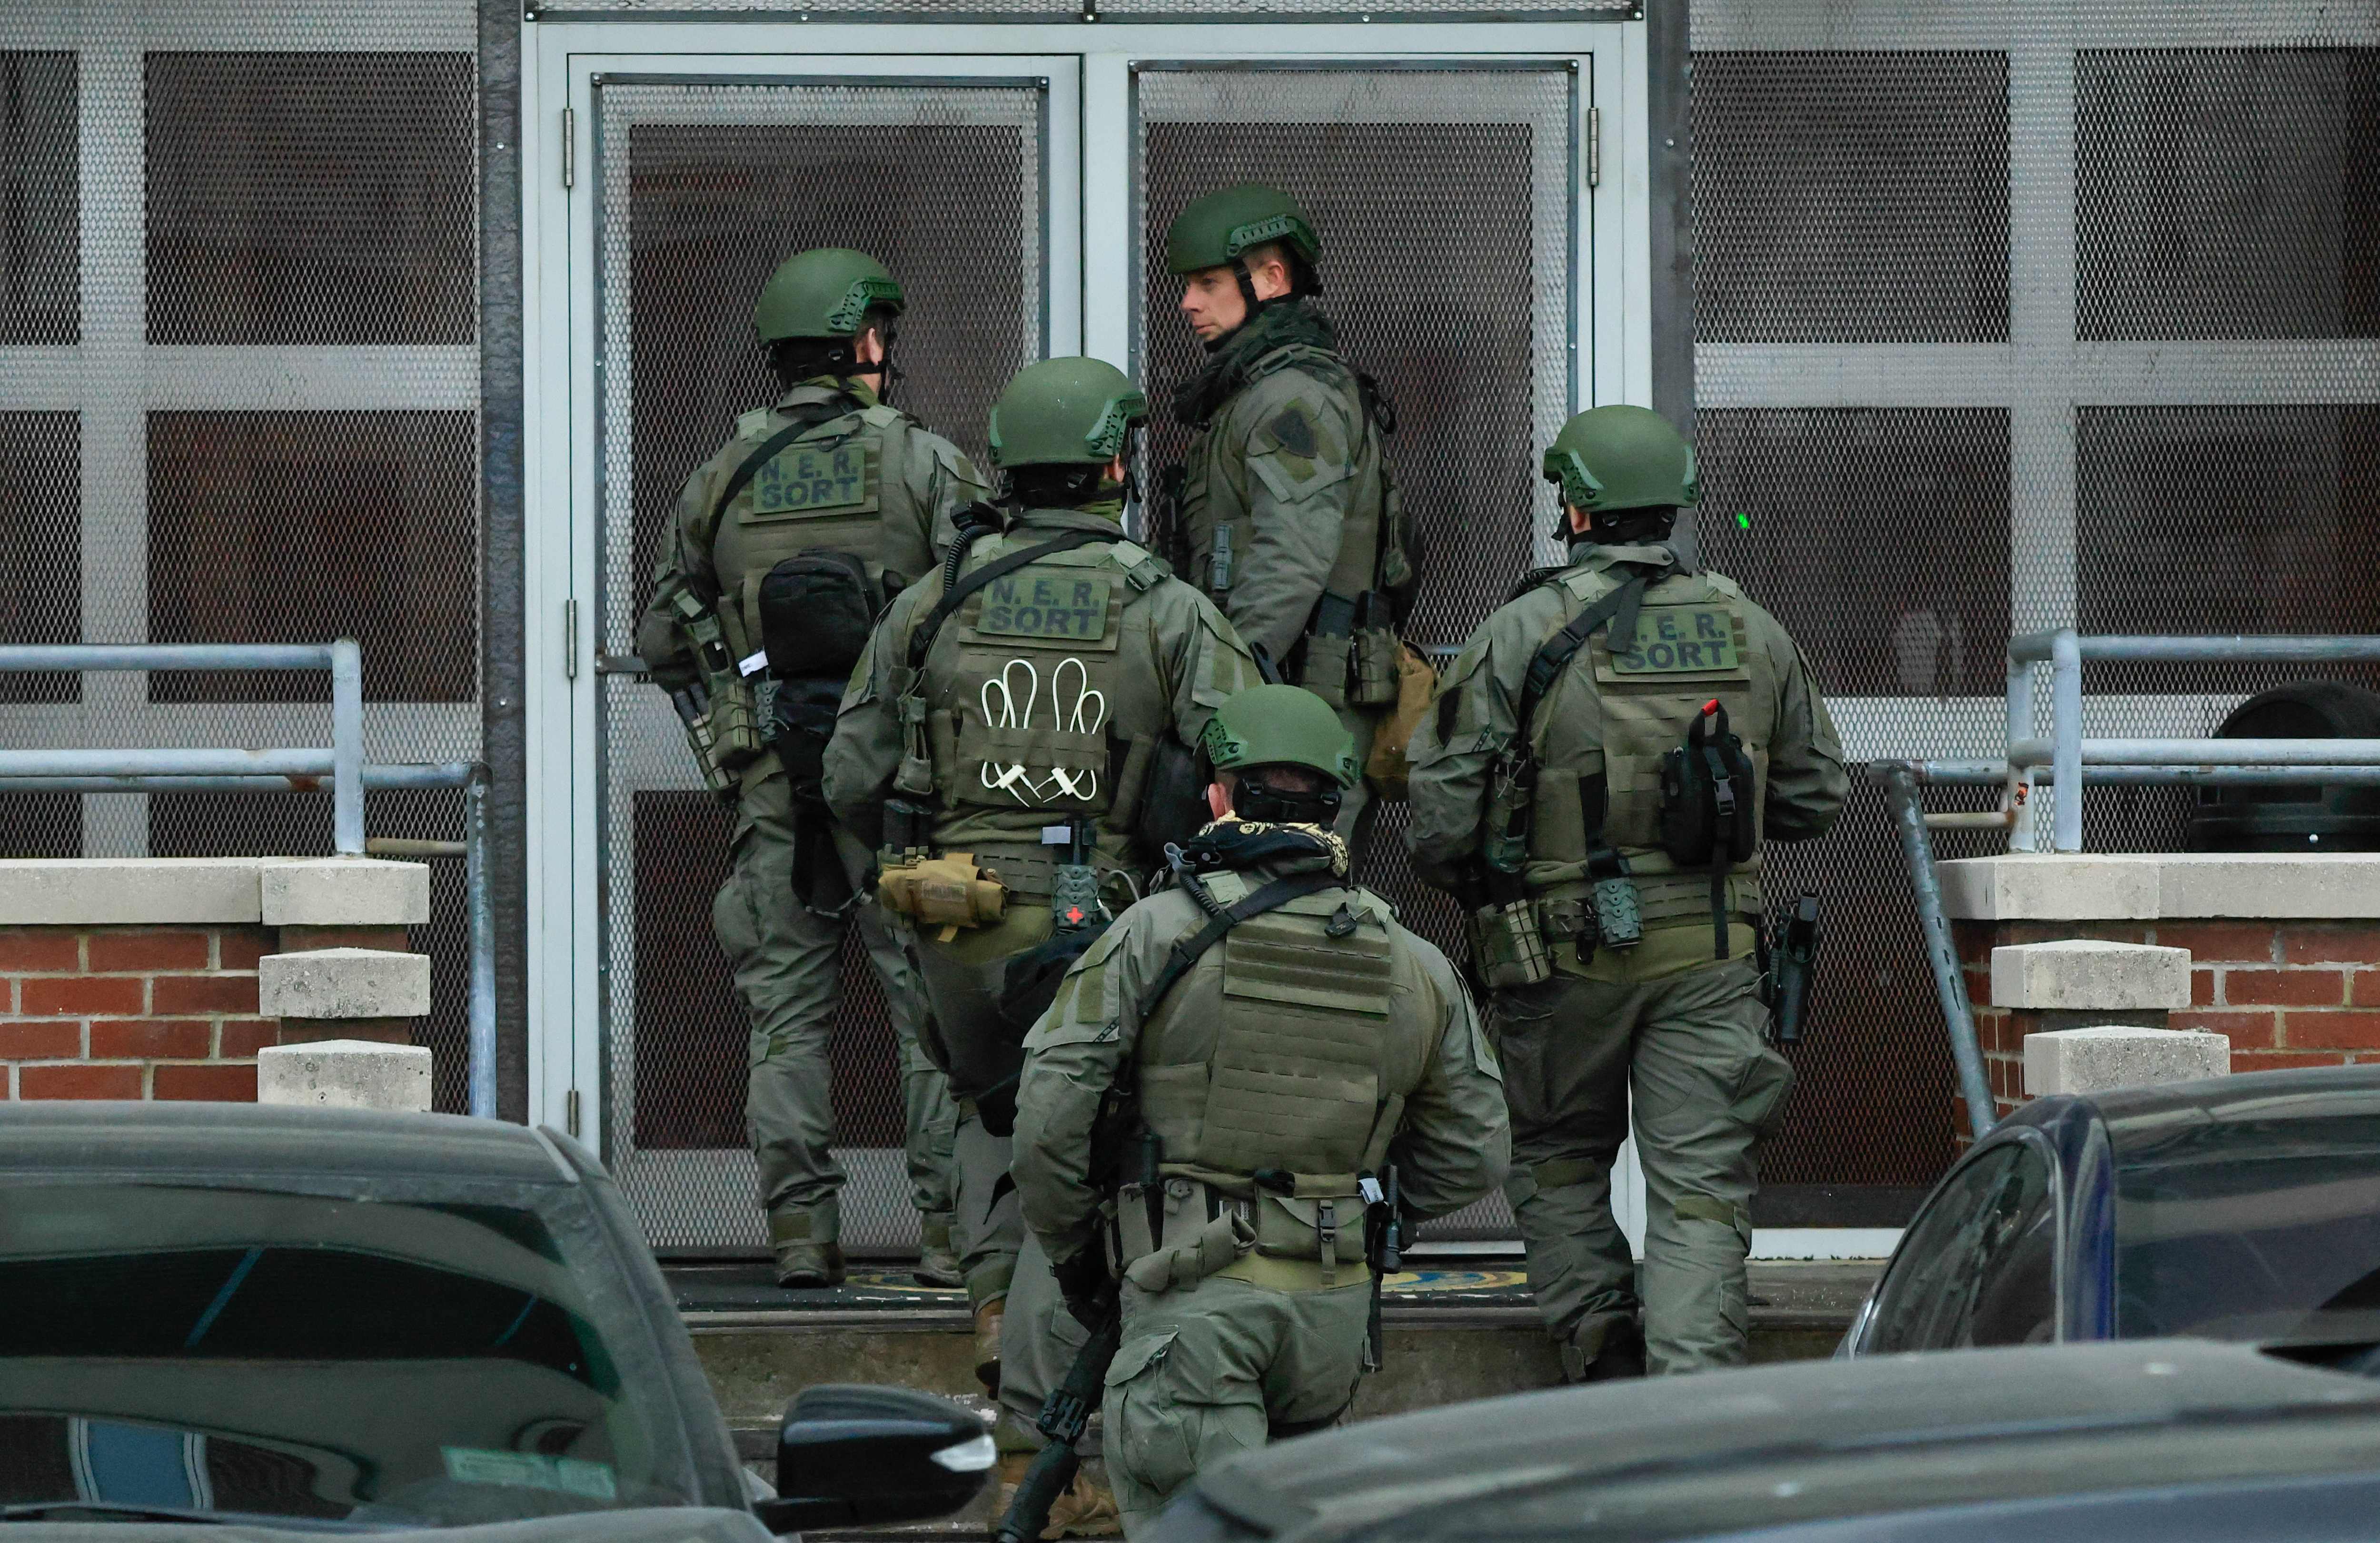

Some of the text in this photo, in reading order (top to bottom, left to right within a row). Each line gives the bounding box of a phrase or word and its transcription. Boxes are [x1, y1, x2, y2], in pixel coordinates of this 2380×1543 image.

[762, 476, 858, 509] SORT
[988, 606, 1098, 634] SORT
[1623, 641, 1727, 669] SORT
